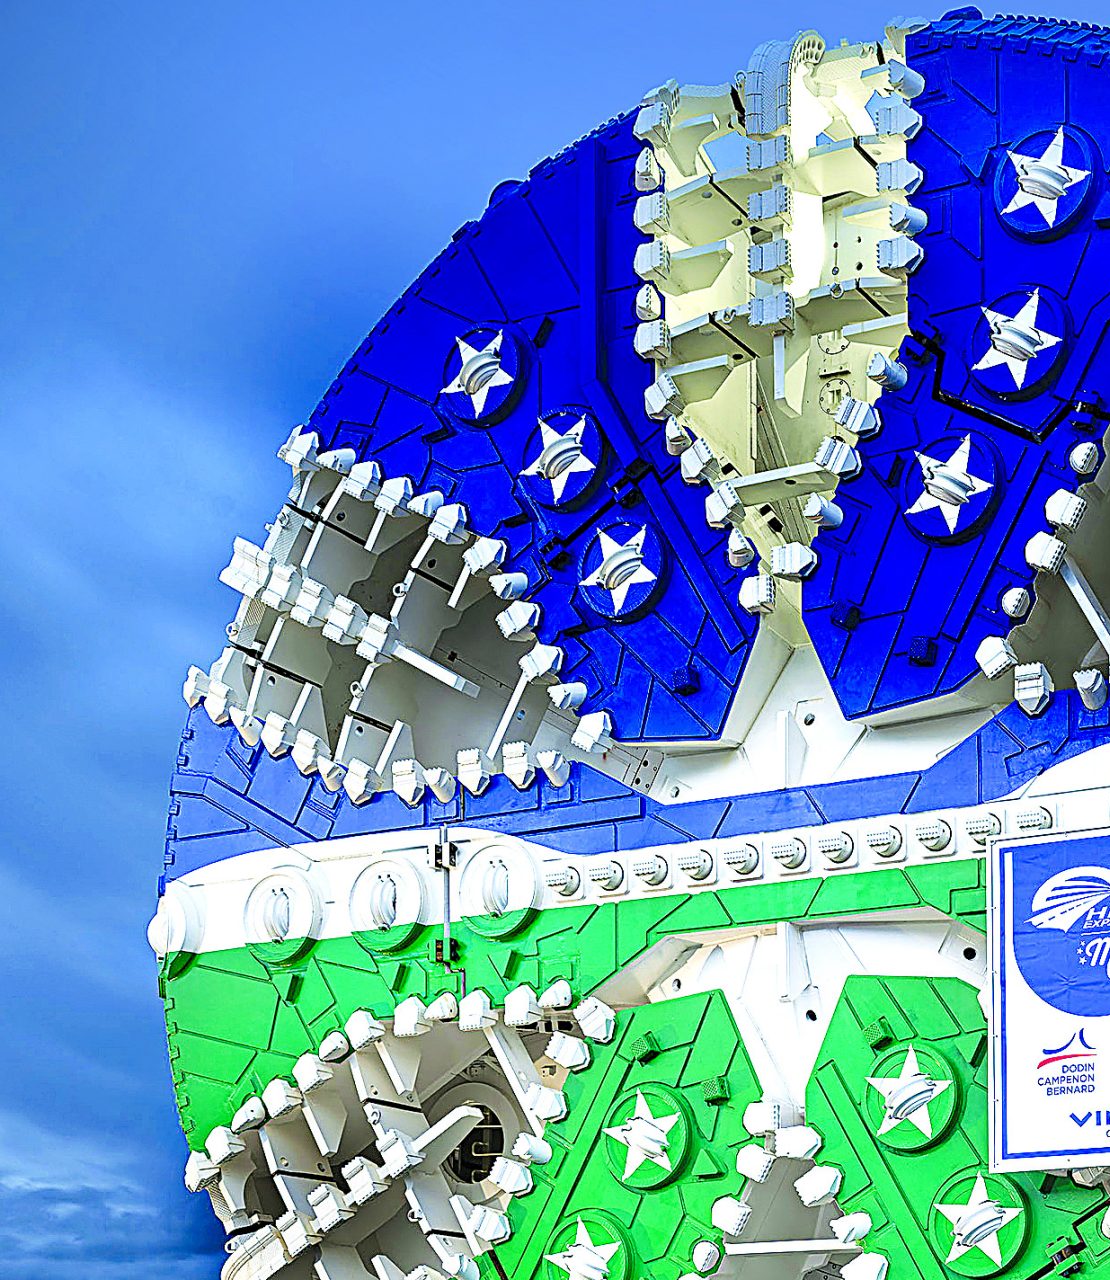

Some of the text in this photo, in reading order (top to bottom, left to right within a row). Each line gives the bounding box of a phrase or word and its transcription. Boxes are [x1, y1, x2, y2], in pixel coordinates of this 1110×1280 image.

[1061, 1062, 1095, 1074] DODIN
[1037, 1073, 1095, 1087] CAMPENON
[1046, 1084, 1096, 1096] BERNARD
